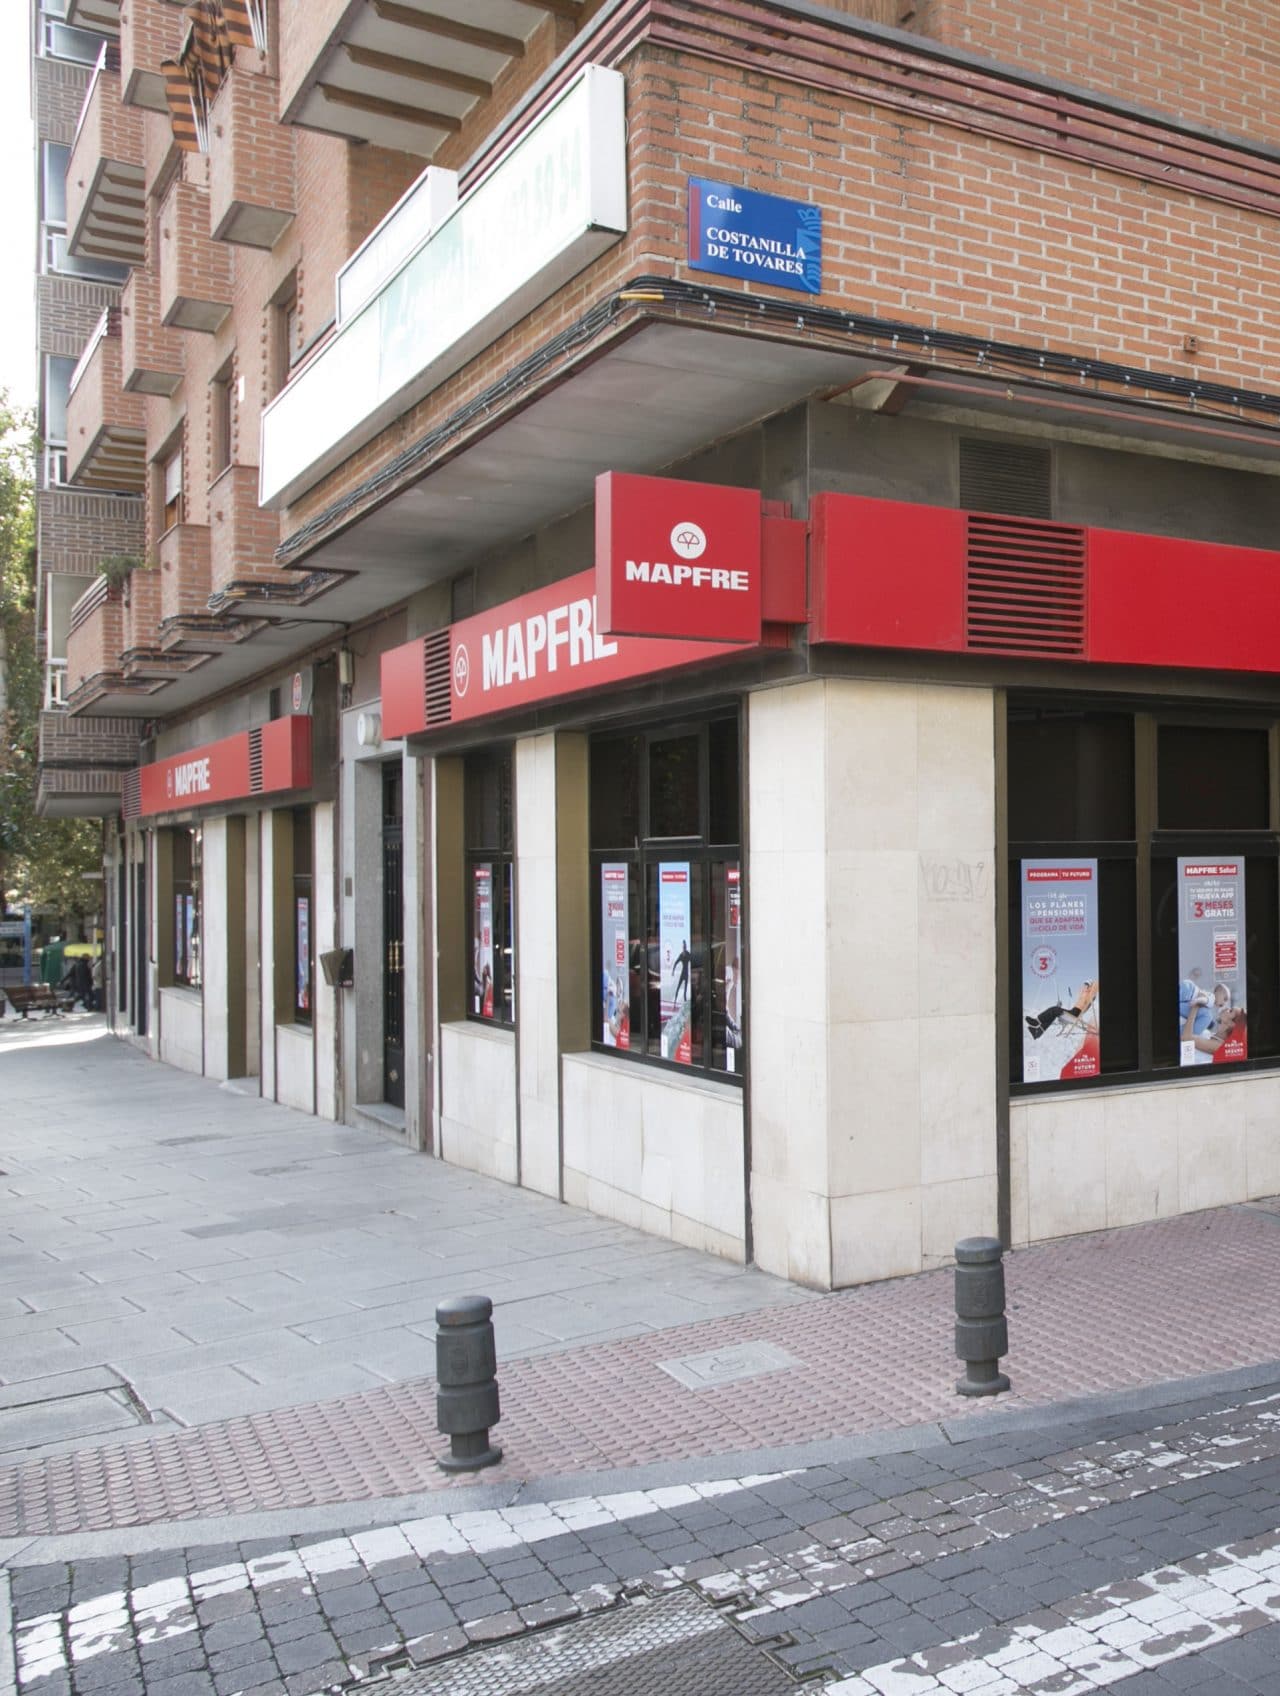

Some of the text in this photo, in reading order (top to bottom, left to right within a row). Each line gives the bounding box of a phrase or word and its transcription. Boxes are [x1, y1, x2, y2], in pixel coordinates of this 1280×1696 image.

[706, 194, 743, 213] Calle
[706, 226, 806, 260] COSTANILLA
[707, 243, 804, 275] DE TOVARES
[625, 560, 750, 591] MAPFRE
[174, 757, 211, 797] MAPFRE
[1186, 866, 1217, 874] MAPFRE
[1029, 901, 1084, 910] LOS PLANES
[1037, 909, 1084, 917] PENSIONES
[1194, 902, 1204, 918] 3
[1204, 908, 1235, 917] GRATIS
